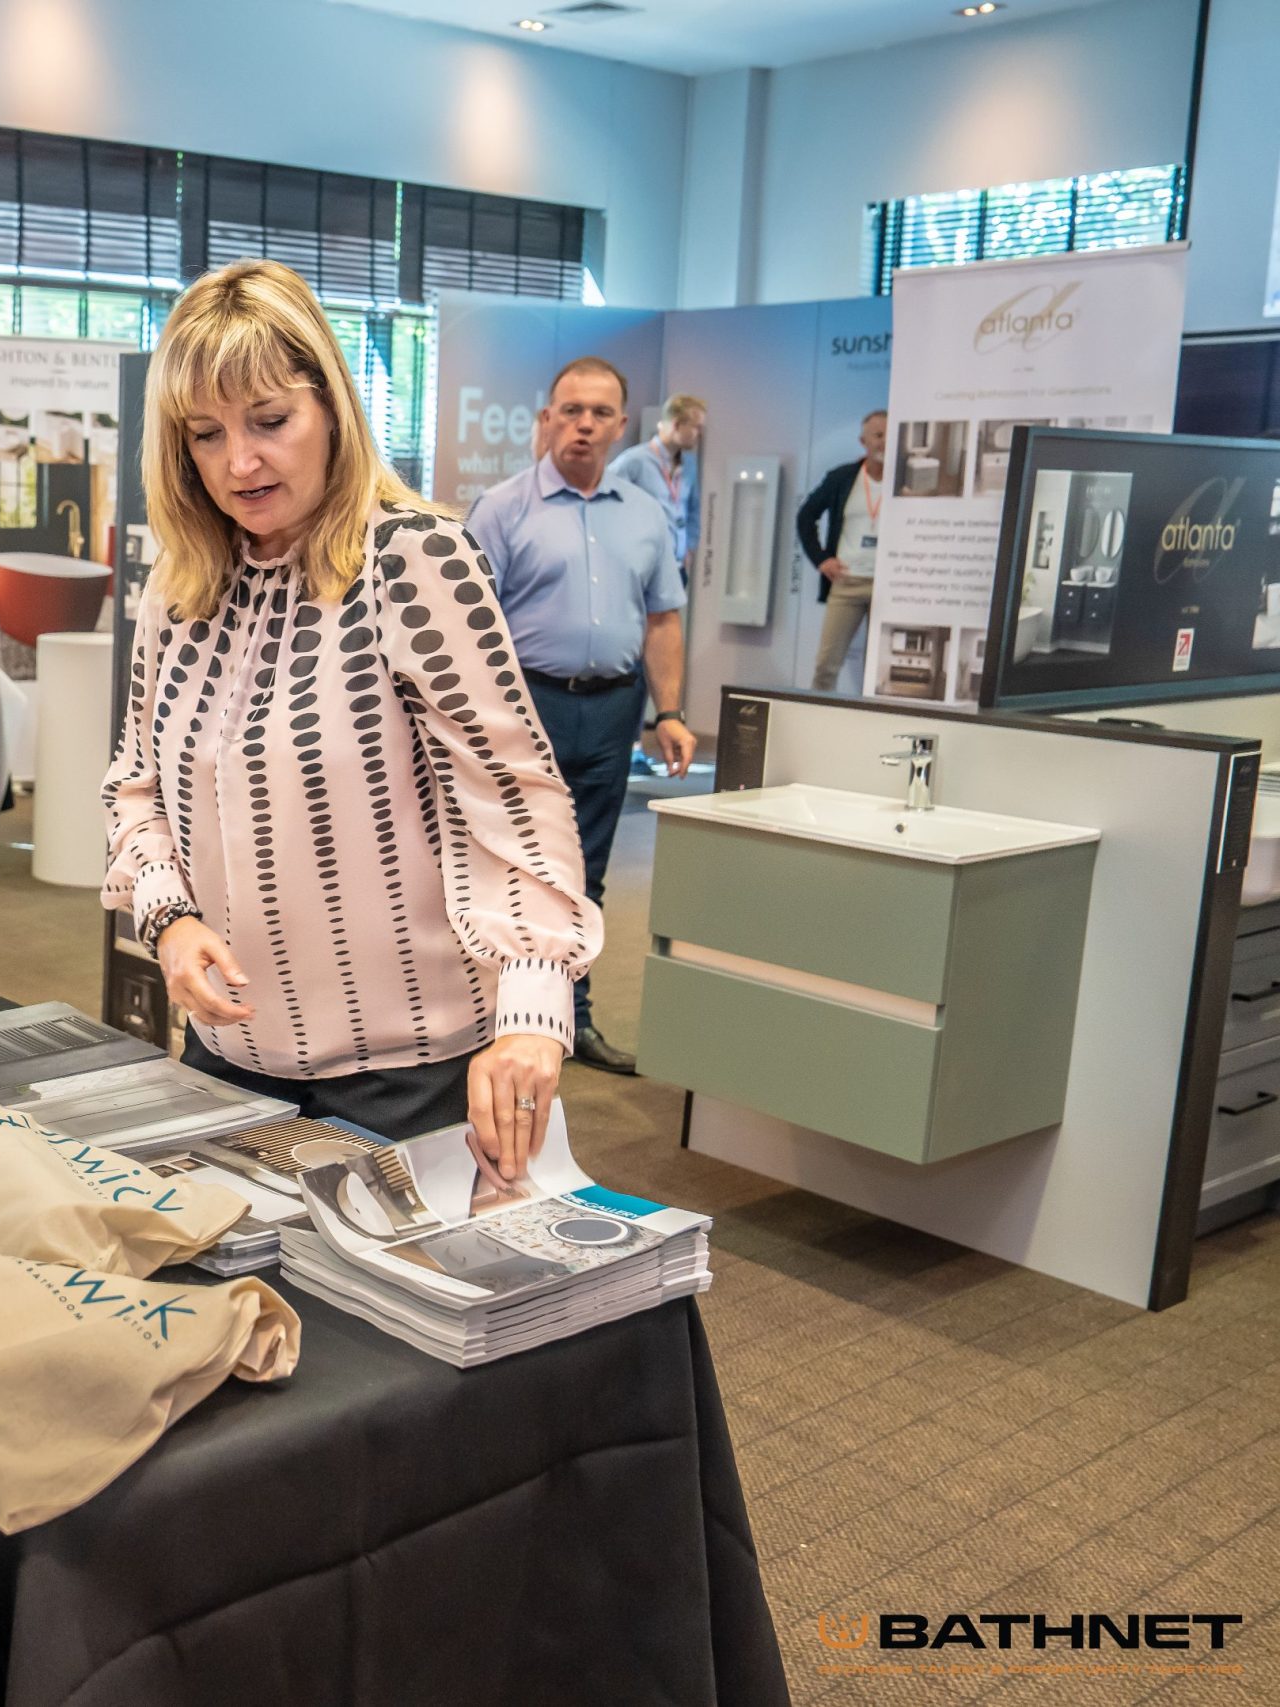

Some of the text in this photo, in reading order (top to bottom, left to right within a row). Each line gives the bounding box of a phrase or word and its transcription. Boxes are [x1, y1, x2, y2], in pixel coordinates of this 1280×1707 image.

[980, 310, 1073, 335] atlanta
[53, 353, 66, 365] &
[71, 354, 118, 368] BENTL
[1161, 517, 1235, 551] atlanta
[584, 1201, 639, 1220] GALLERY
[26, 1266, 162, 1350] BATHROOM UTION
